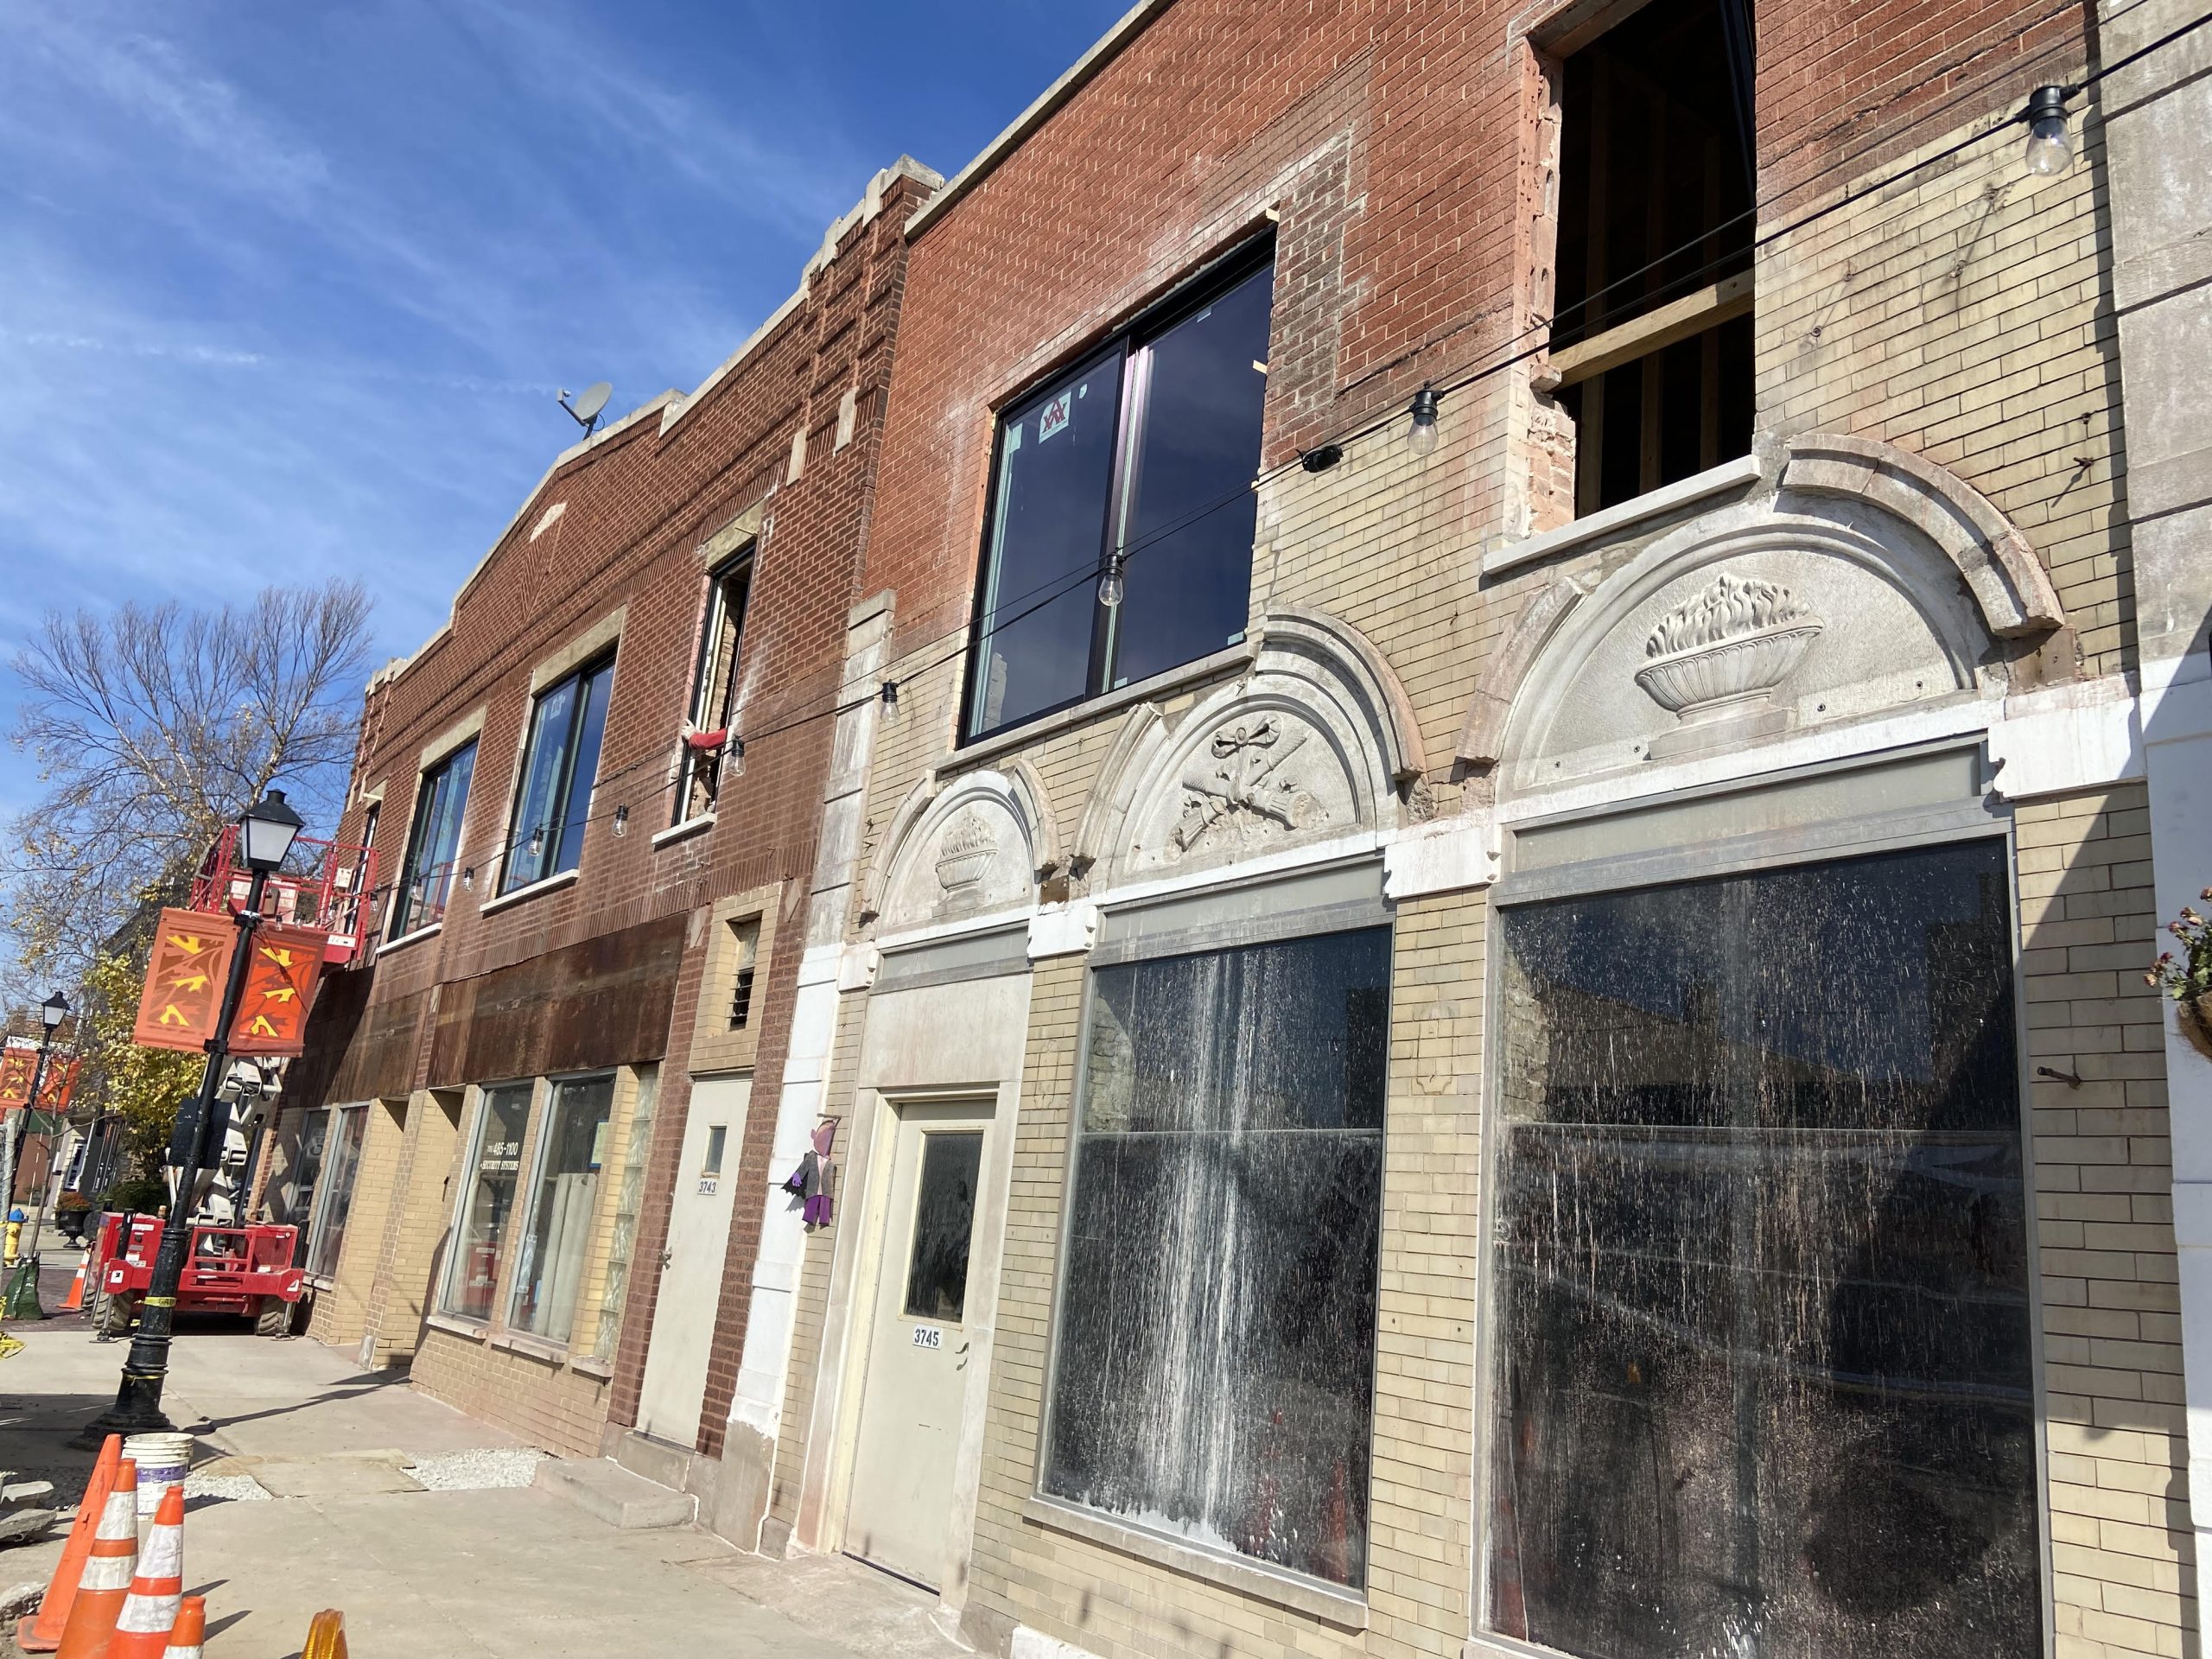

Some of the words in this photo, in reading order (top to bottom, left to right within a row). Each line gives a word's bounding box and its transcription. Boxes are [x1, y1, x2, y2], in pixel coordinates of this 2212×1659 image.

[493, 1142, 518, 1156] 485-1100
[500, 1160, 519, 1171] SYSTEMS
[699, 1181, 716, 1194] 3743
[914, 1328, 939, 1346] 3745
